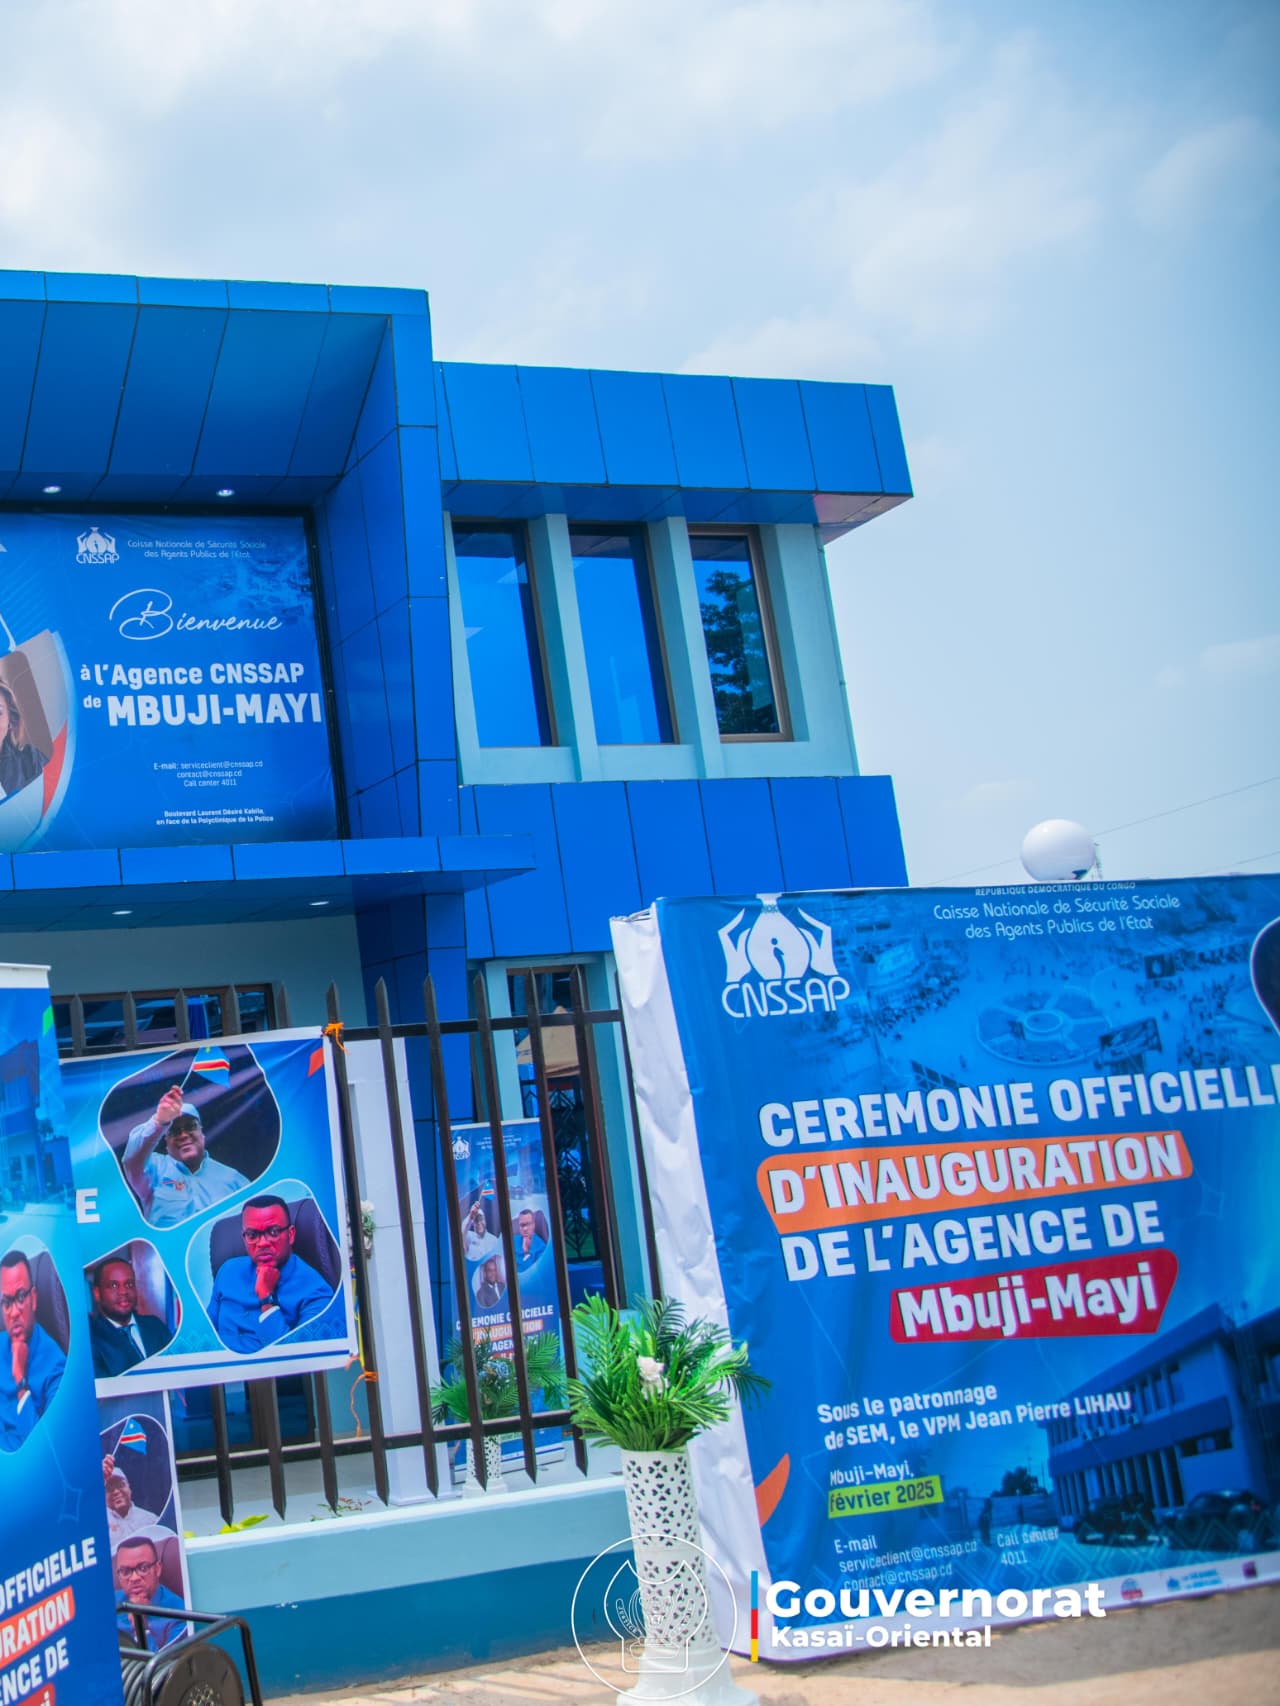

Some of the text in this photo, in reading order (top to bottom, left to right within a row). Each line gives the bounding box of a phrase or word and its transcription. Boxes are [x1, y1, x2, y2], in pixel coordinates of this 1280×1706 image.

[76, 553, 120, 564] CNSSAP
[144, 550, 159, 558] des
[160, 550, 188, 560] Agents
[218, 550, 229, 558] de
[195, 540, 205, 549] de
[109, 588, 283, 641] Bienvenue
[80, 662, 305, 690] à l'Agence CNSSAP
[83, 692, 322, 727] de MBUJI-MAYI
[933, 894, 1180, 920] Caisse Nationale de Sécurité Sociale
[965, 924, 991, 939] des
[995, 922, 1043, 941] Agents
[1048, 918, 1095, 933] Publics
[1099, 917, 1116, 931] de
[721, 975, 850, 1019] CNSSAP
[758, 1081, 1040, 1148] CEREMONIE
[767, 1133, 1185, 1216] D'INAUGURATION
[75, 1188, 100, 1224] E
[781, 1200, 1165, 1283] DE L'AGENCE DE
[897, 1262, 1158, 1339] Mbuji-Mayi
[456, 1312, 505, 1331] CEMONIE
[506, 1305, 553, 1322] OICIELLE
[817, 1384, 998, 1423] Sous le patronnage
[824, 1391, 1132, 1450] de SEM, le VPM Jean Pierre LIHAU
[829, 1460, 915, 1487] Mbuji-Mayi,
[829, 1480, 935, 1513] février 2025
[834, 1527, 1059, 1555] E-mail Call center
[839, 1540, 1028, 1573] serviceclient@cnssap.cd 4011
[44, 1637, 69, 1679] DE
